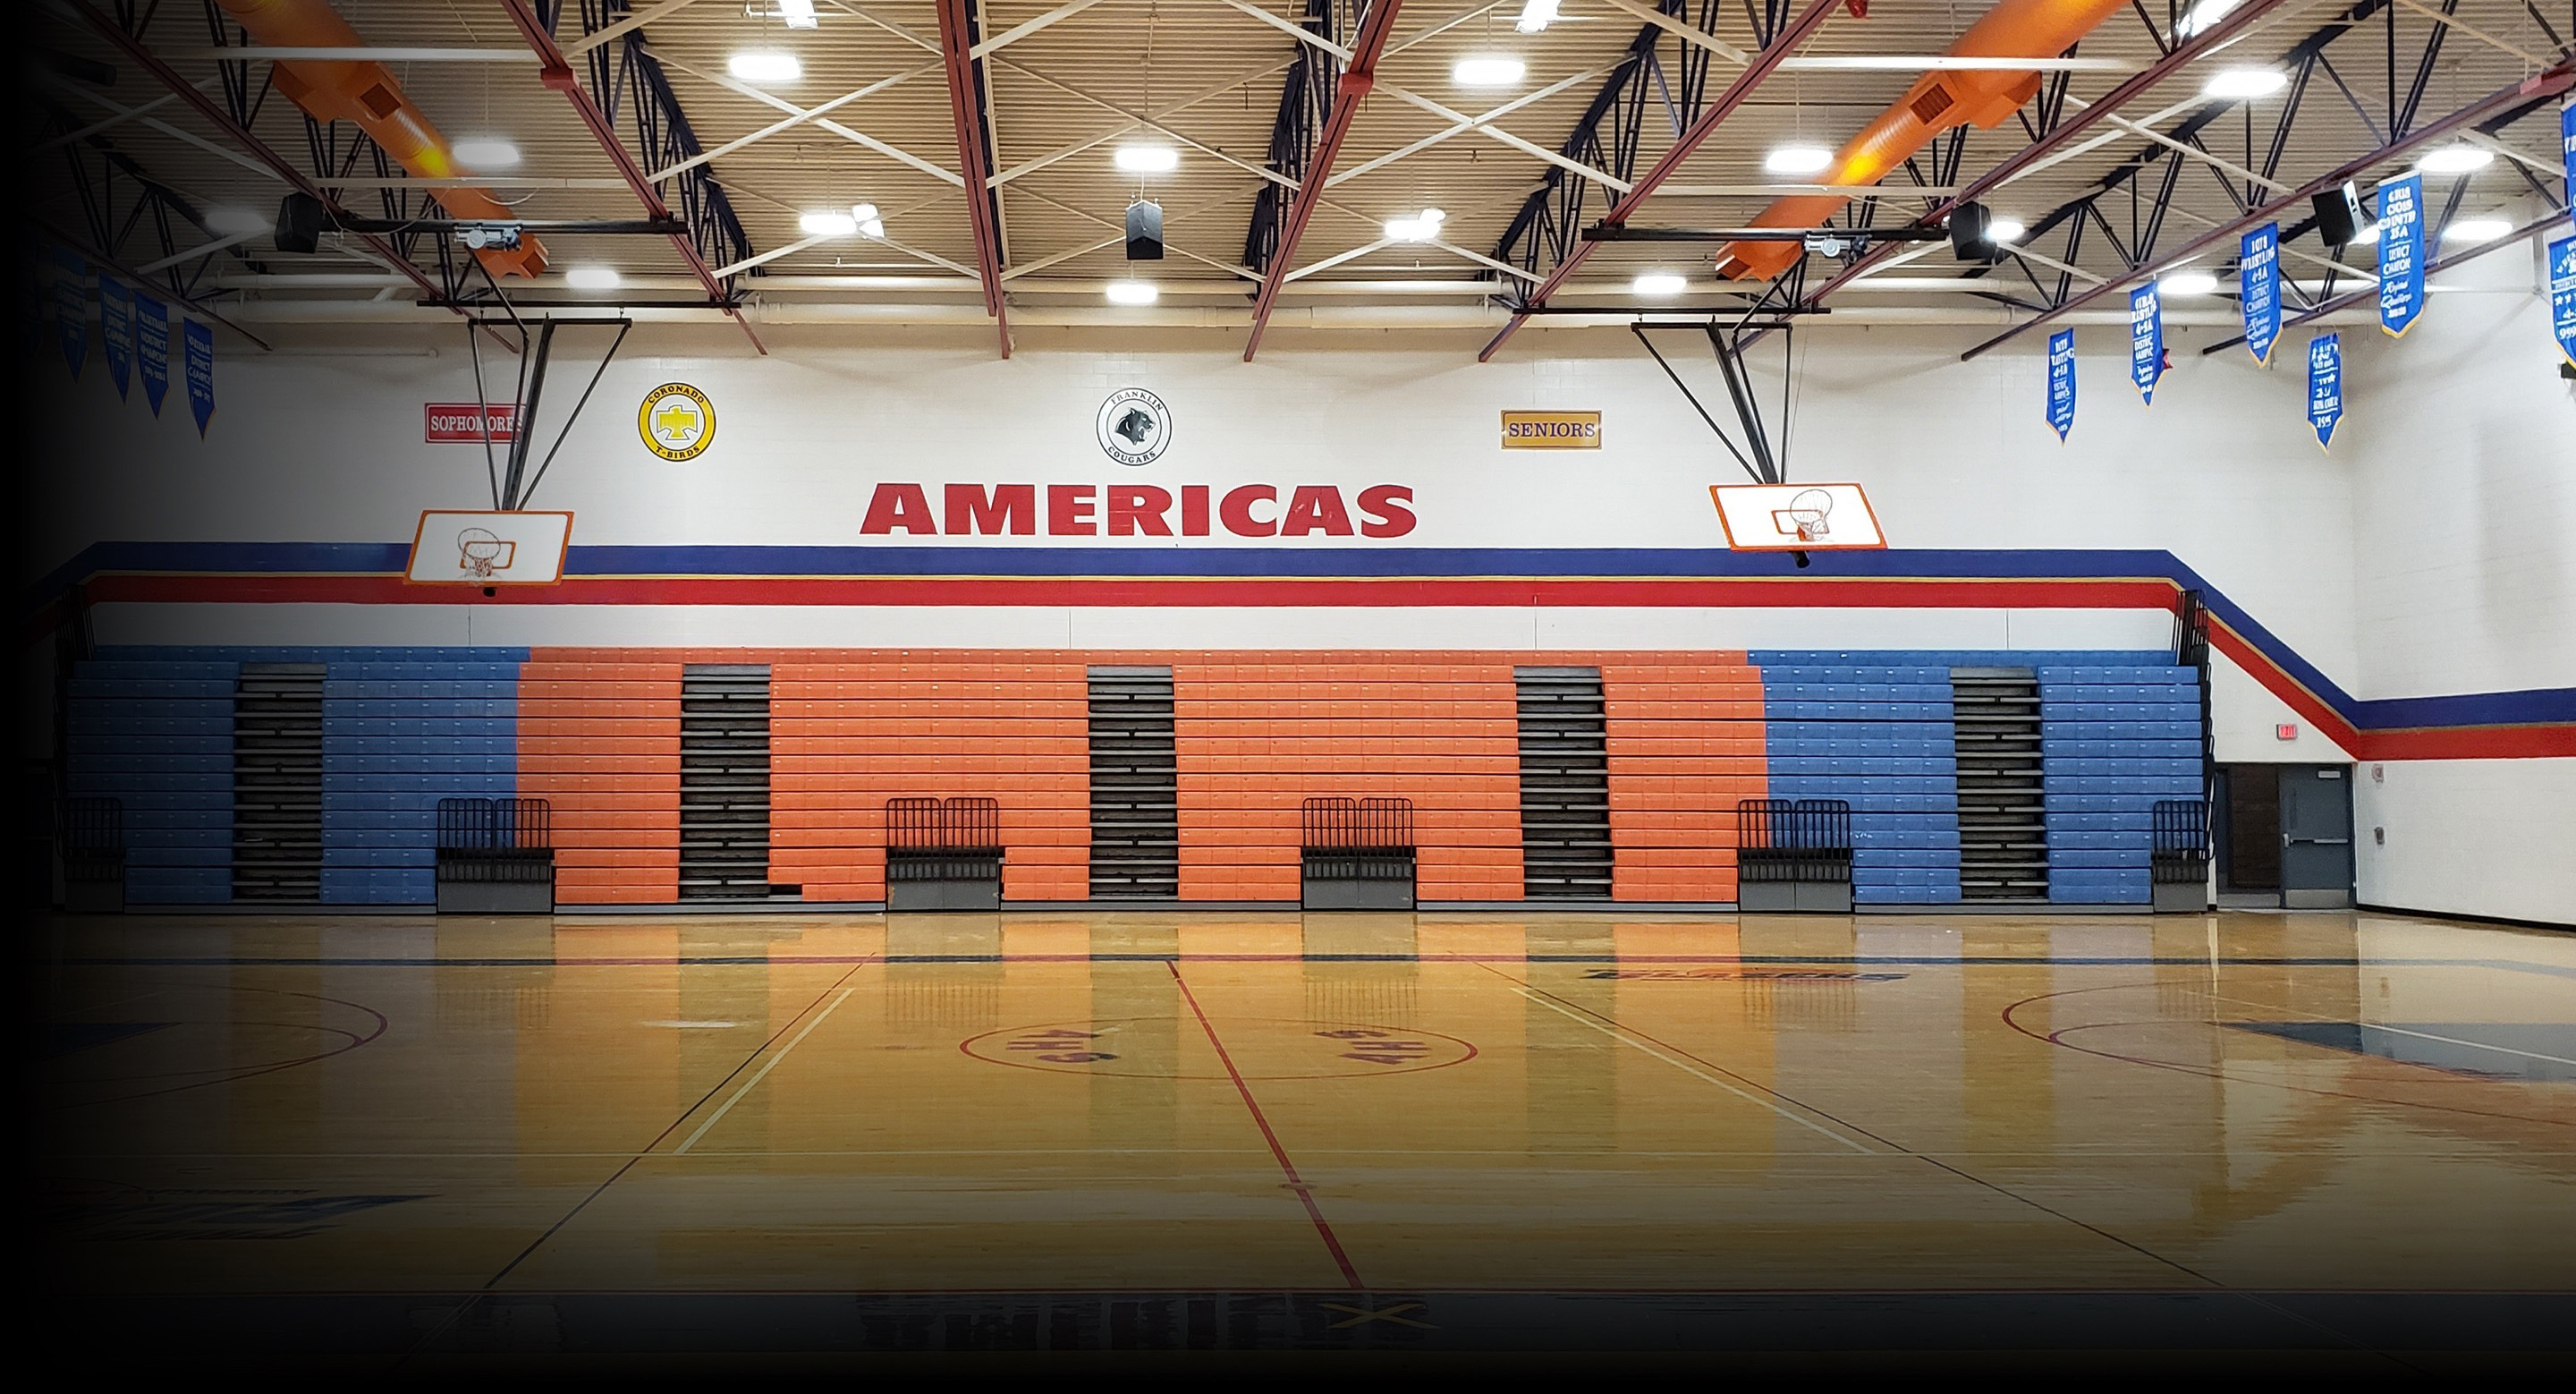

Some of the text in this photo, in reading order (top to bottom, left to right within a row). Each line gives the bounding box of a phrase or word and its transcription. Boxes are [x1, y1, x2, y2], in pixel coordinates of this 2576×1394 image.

[648, 386, 704, 404] CORONADO
[1111, 391, 1163, 411] FRANKLIN
[1508, 422, 1596, 438] SENIORS
[656, 446, 700, 459] T-BIRDS
[1108, 446, 1157, 463] COUGARS
[859, 482, 1418, 539] AMERICAS
